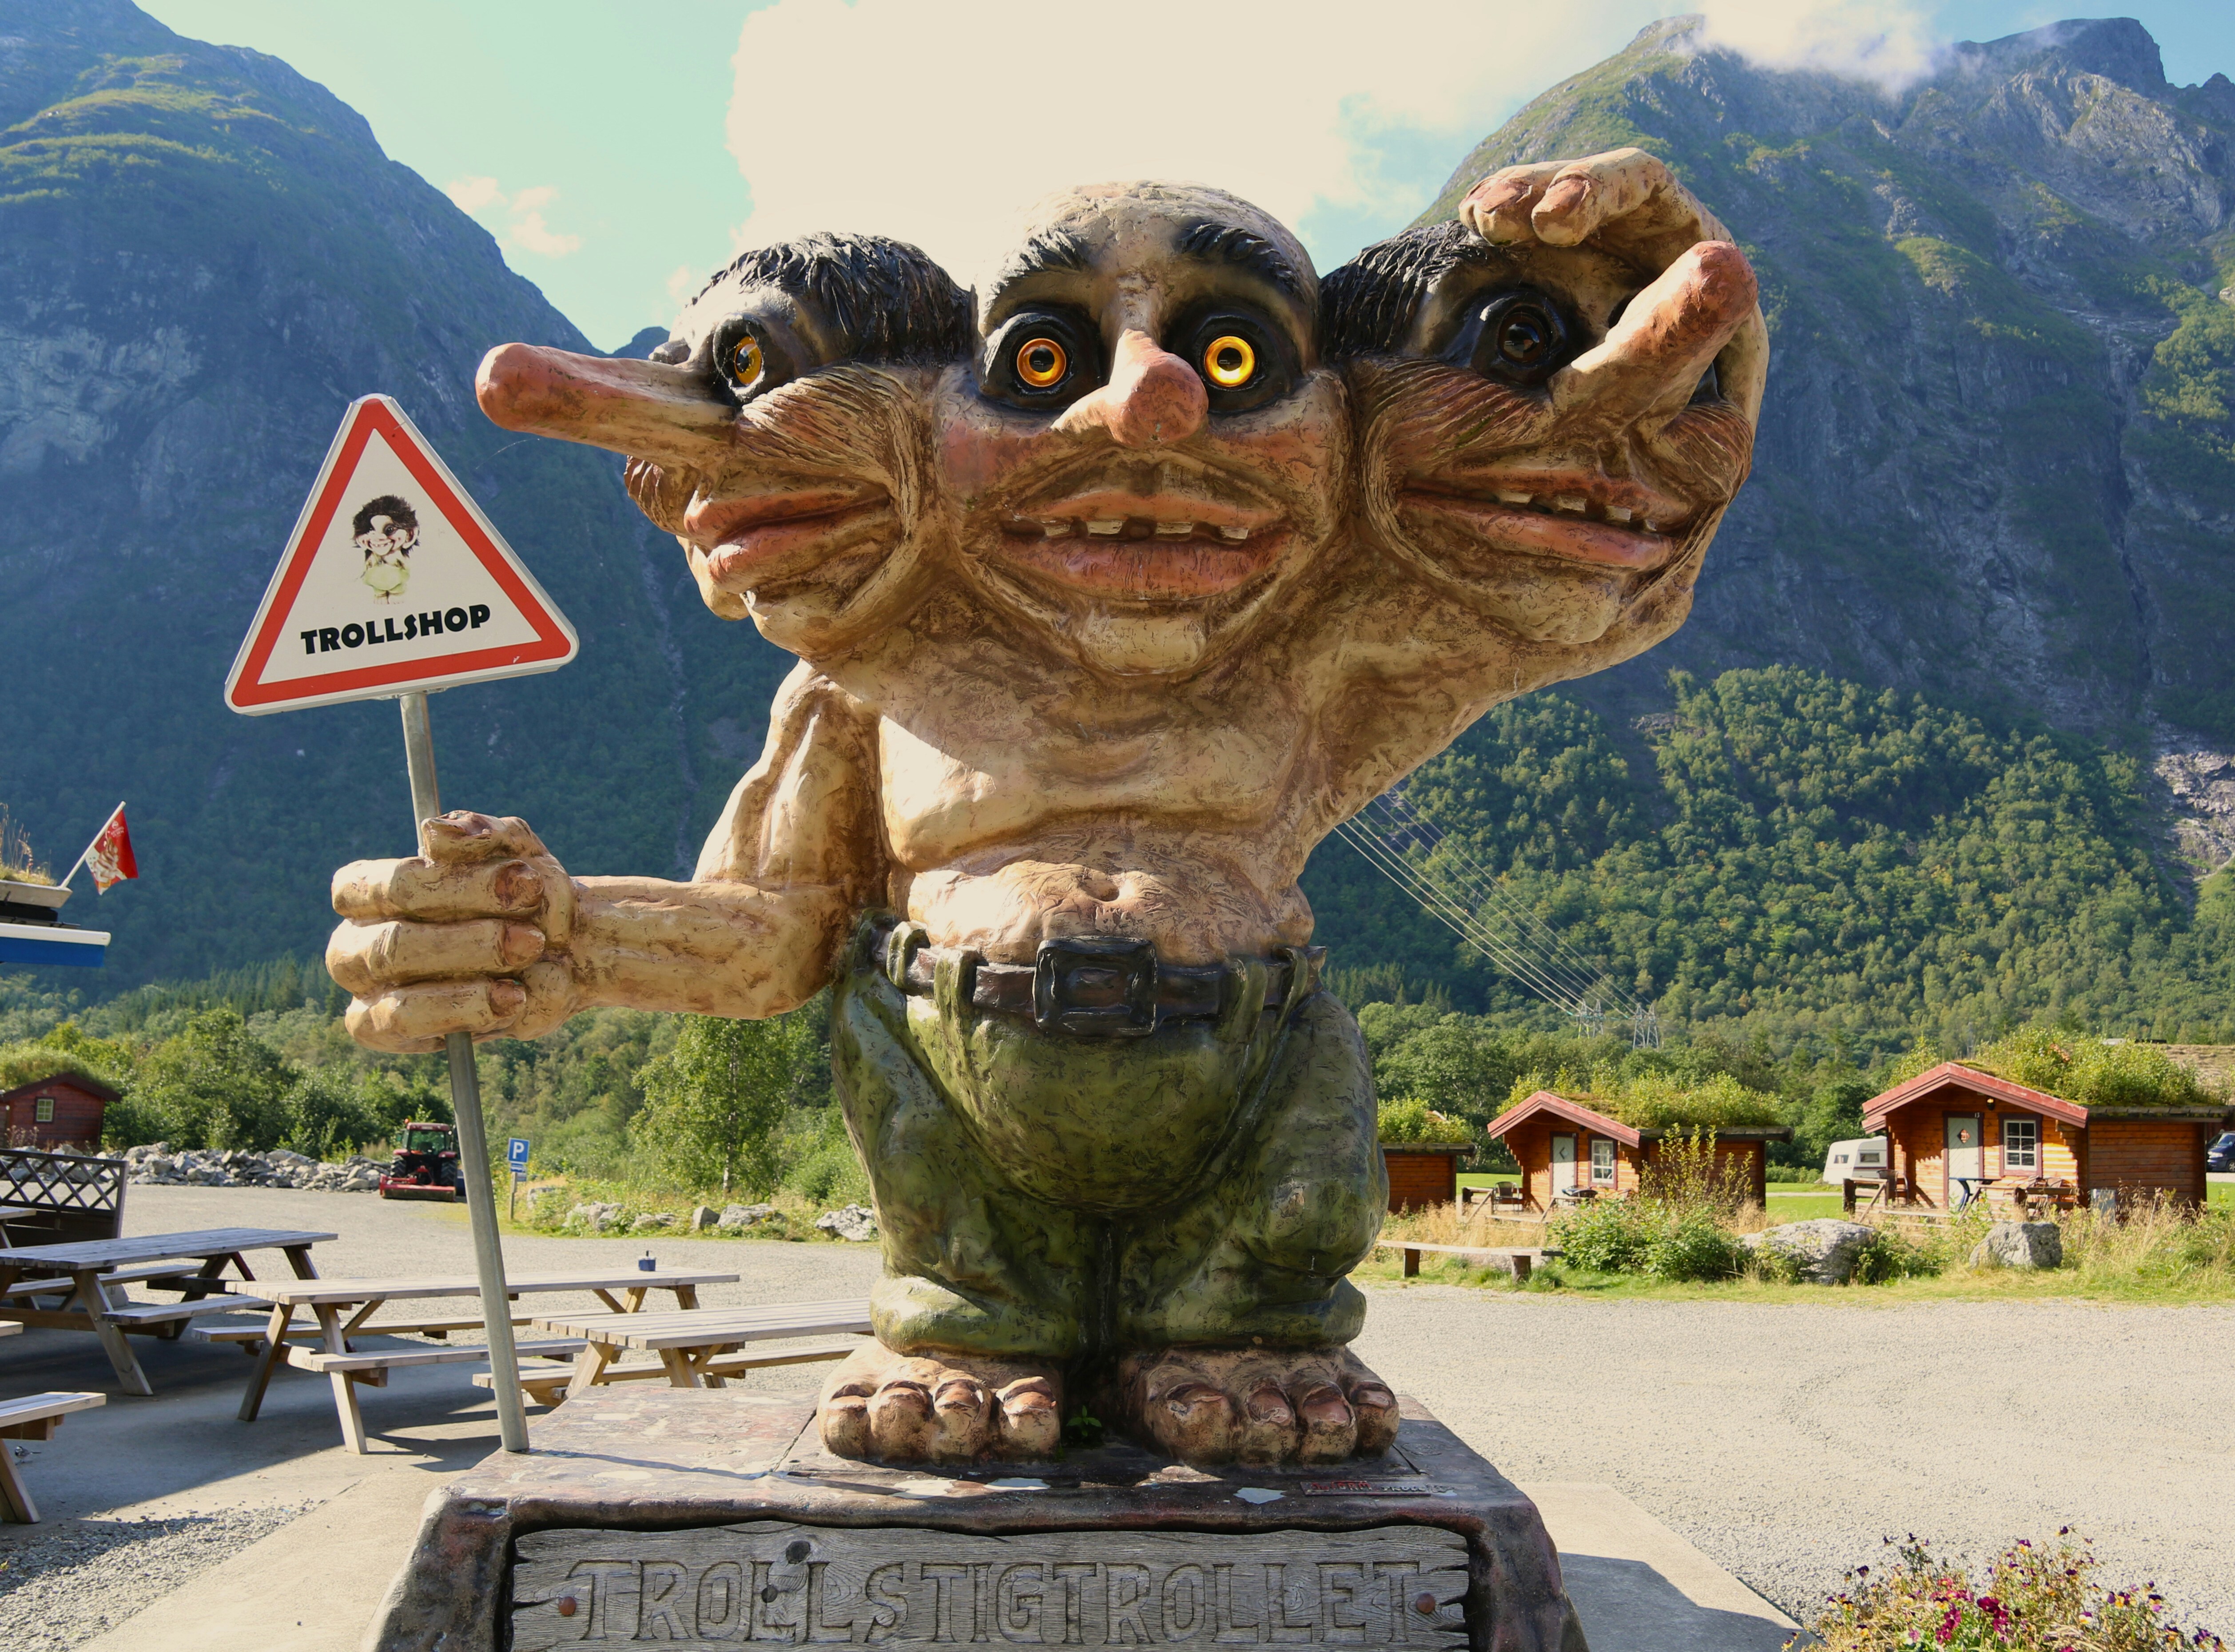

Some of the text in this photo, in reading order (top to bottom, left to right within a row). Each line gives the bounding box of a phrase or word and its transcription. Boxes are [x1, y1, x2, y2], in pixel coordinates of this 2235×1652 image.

[301, 604, 490, 655] TROLLSHOP
[513, 1142, 524, 1159] P
[566, 1560, 1420, 1644] TROLLSTIGTROLLET
